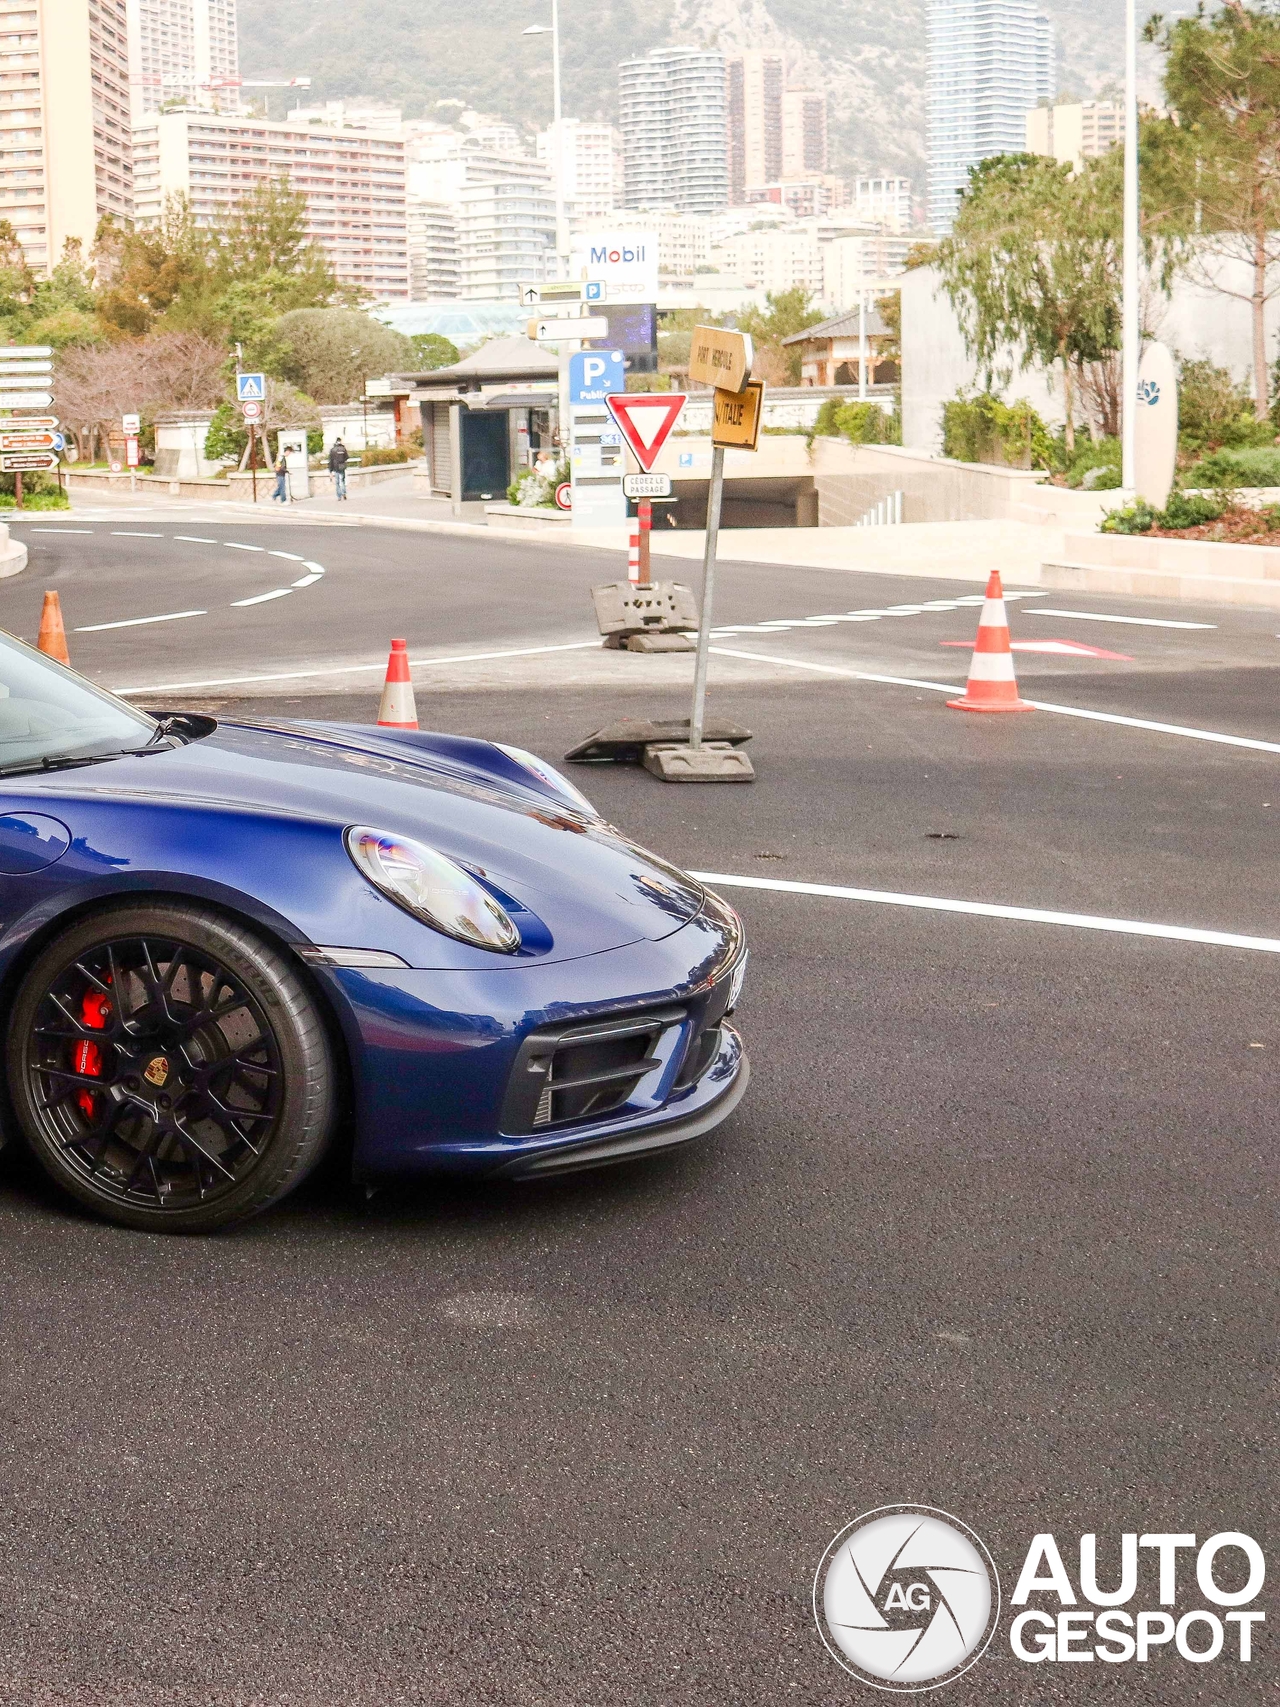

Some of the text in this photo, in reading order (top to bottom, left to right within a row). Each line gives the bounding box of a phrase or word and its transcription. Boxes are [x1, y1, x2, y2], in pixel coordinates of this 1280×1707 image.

[590, 245, 646, 264] Mobil
[583, 357, 606, 386] P
[630, 476, 664, 485] CÉDEZ LE
